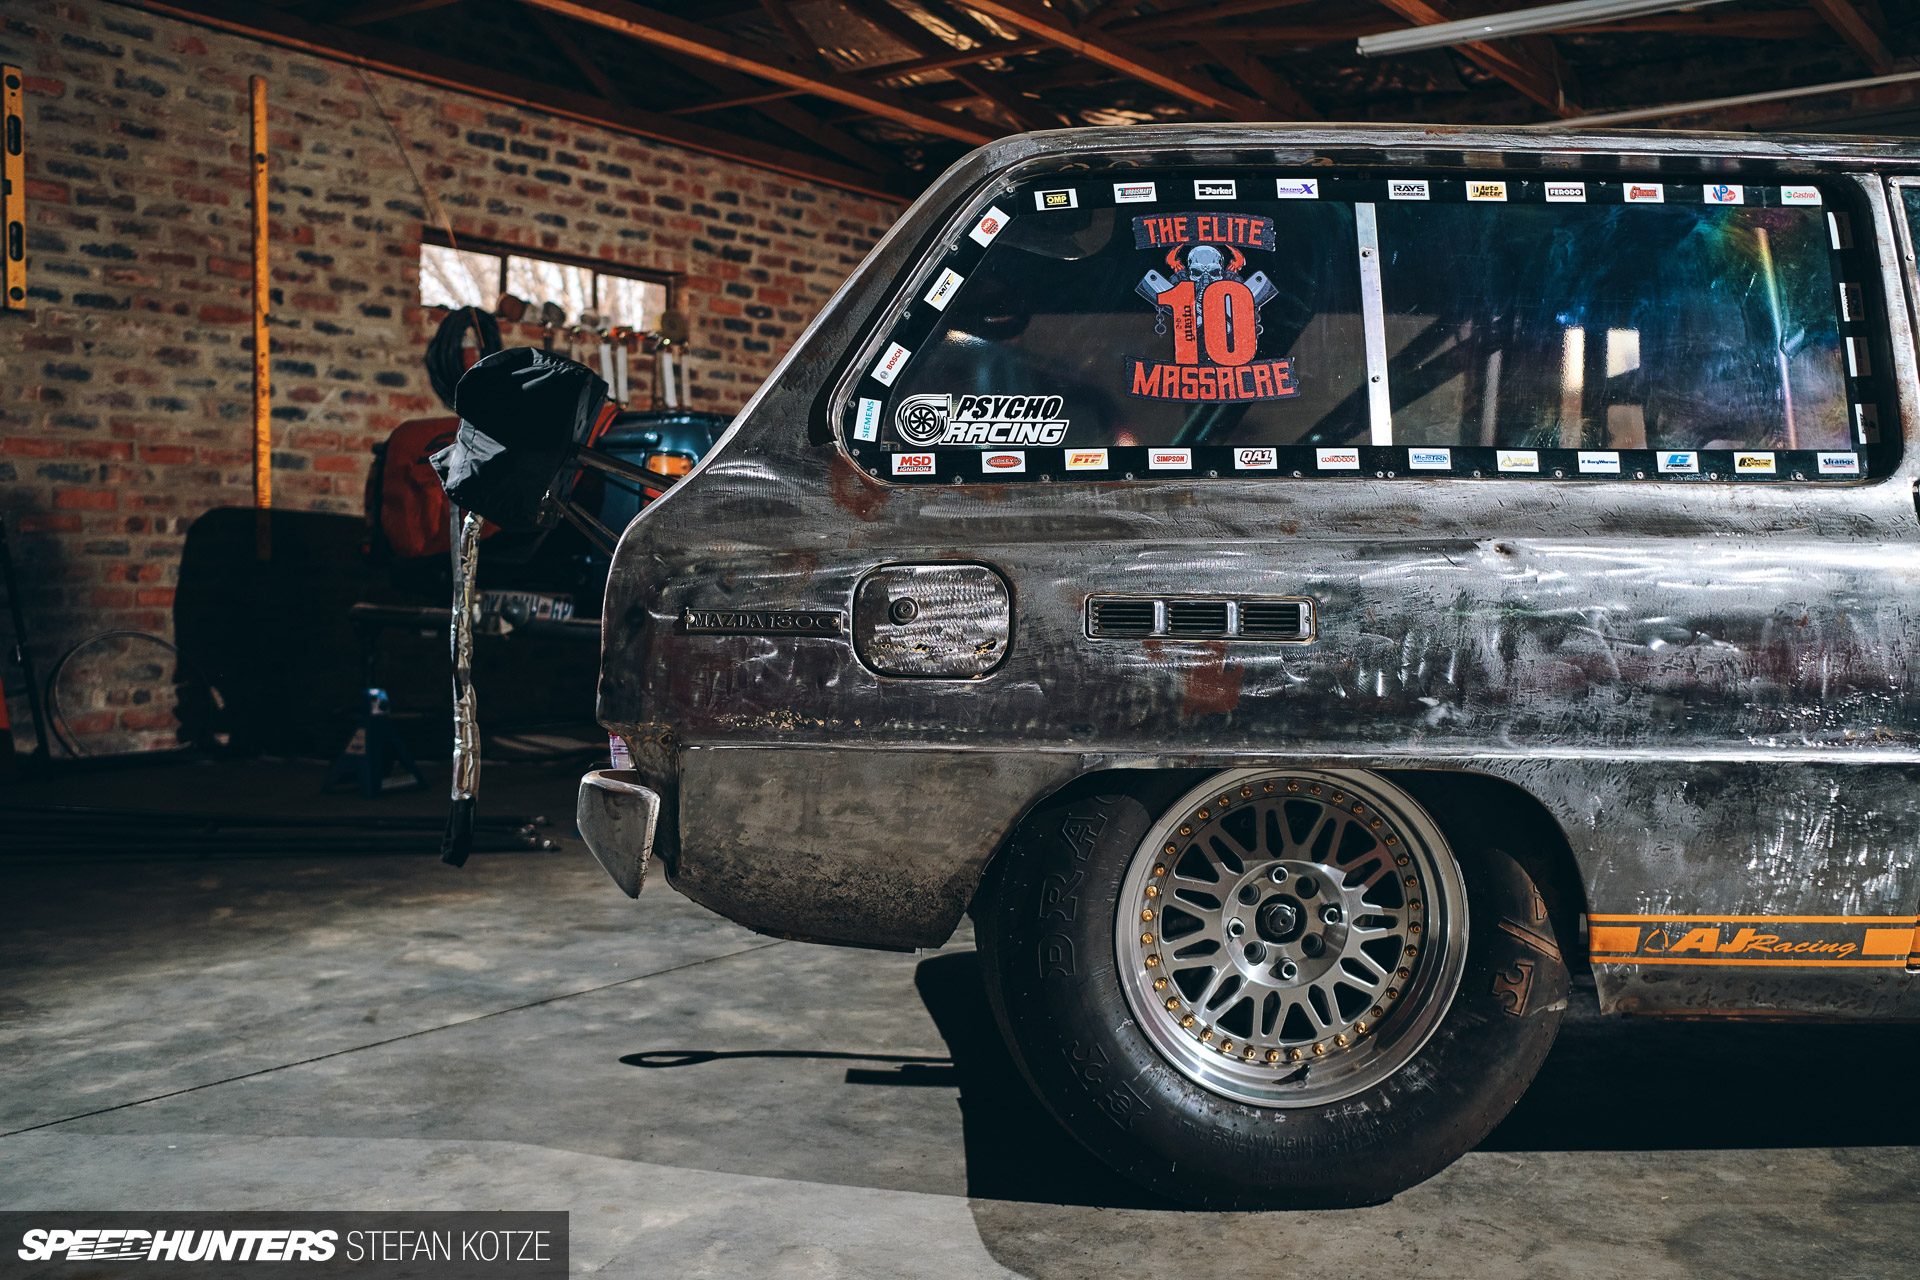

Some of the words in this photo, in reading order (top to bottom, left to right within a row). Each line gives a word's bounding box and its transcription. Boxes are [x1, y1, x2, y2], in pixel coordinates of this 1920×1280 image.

[1046, 195, 1067, 204] OMP
[1205, 187, 1233, 195] Parker
[1713, 185, 1729, 201] VP
[1793, 191, 1816, 199] Castrol
[1143, 217, 1189, 244] THE
[1197, 216, 1265, 246] ELITE
[1157, 280, 1257, 366] 10
[886, 348, 904, 370] BOSCH
[1132, 361, 1295, 400] MASSACRE
[956, 397, 1062, 420] PSYCHO
[862, 401, 875, 439] SIEMENS
[944, 423, 1065, 443] RACING
[900, 456, 931, 466] MSD
[1240, 450, 1272, 464] QA1
[694, 612, 765, 628] MAZDA
[1668, 928, 1757, 953] AJ
[1746, 933, 1859, 959] Racing
